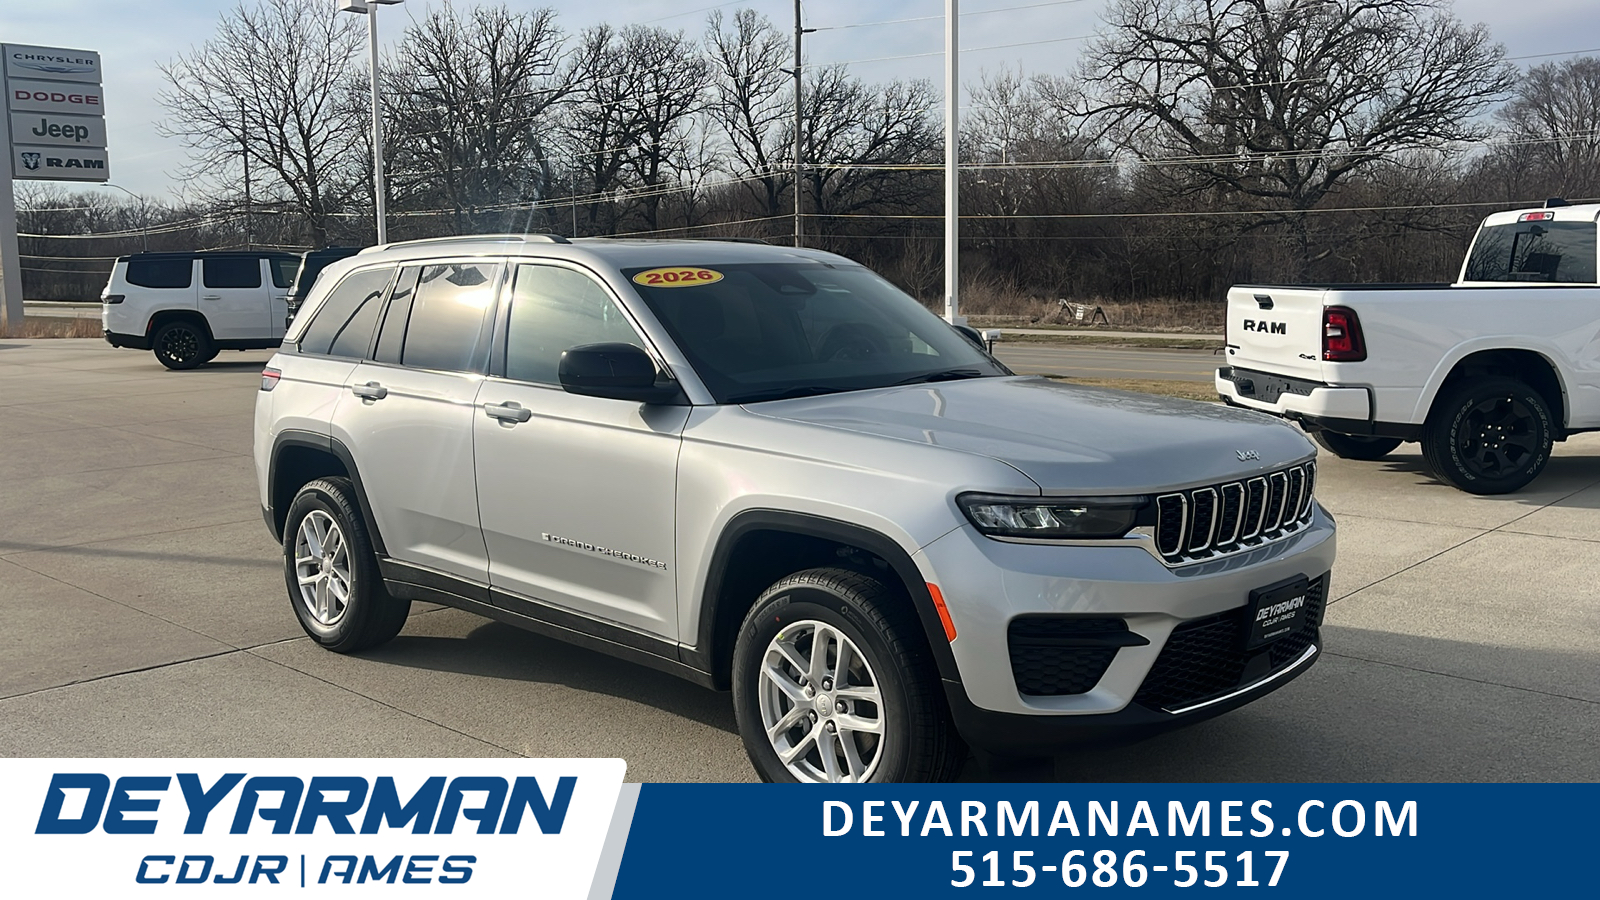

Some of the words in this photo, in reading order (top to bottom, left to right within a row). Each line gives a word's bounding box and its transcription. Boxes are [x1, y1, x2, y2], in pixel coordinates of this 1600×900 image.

[13, 53, 94, 66] CHRYSLER
[15, 90, 99, 105] DODGE
[32, 118, 89, 142] Jeep
[46, 157, 104, 169] RAM
[645, 270, 714, 285] 2026
[1243, 319, 1287, 335] RAM
[1235, 449, 1260, 462] Jeep
[552, 534, 594, 551] GRAND
[597, 546, 668, 570] CHEROKEE
[1256, 595, 1305, 621] DEYARMAN
